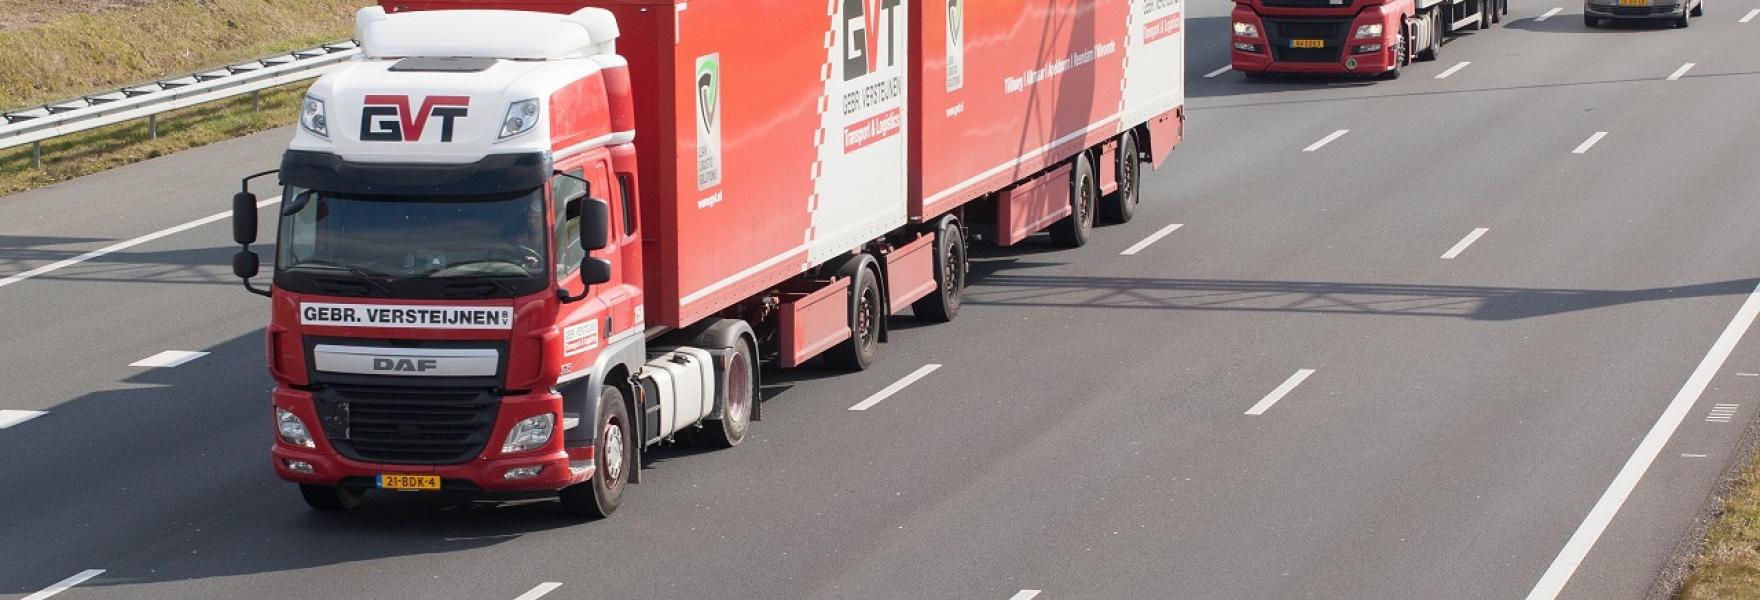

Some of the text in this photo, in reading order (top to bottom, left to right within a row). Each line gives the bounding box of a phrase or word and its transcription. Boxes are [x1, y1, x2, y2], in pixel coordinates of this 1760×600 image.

[843, 0, 901, 82] GVT
[842, 76, 902, 116] GEBR. VERSTEIJNEN
[360, 95, 470, 142] GVT
[844, 119, 870, 147] Transport
[875, 111, 901, 137] Logistics
[304, 307, 500, 325] GEBR. VERSTEIJNEN
[374, 358, 437, 372] DAF
[386, 477, 436, 487] 21-BDK-4
